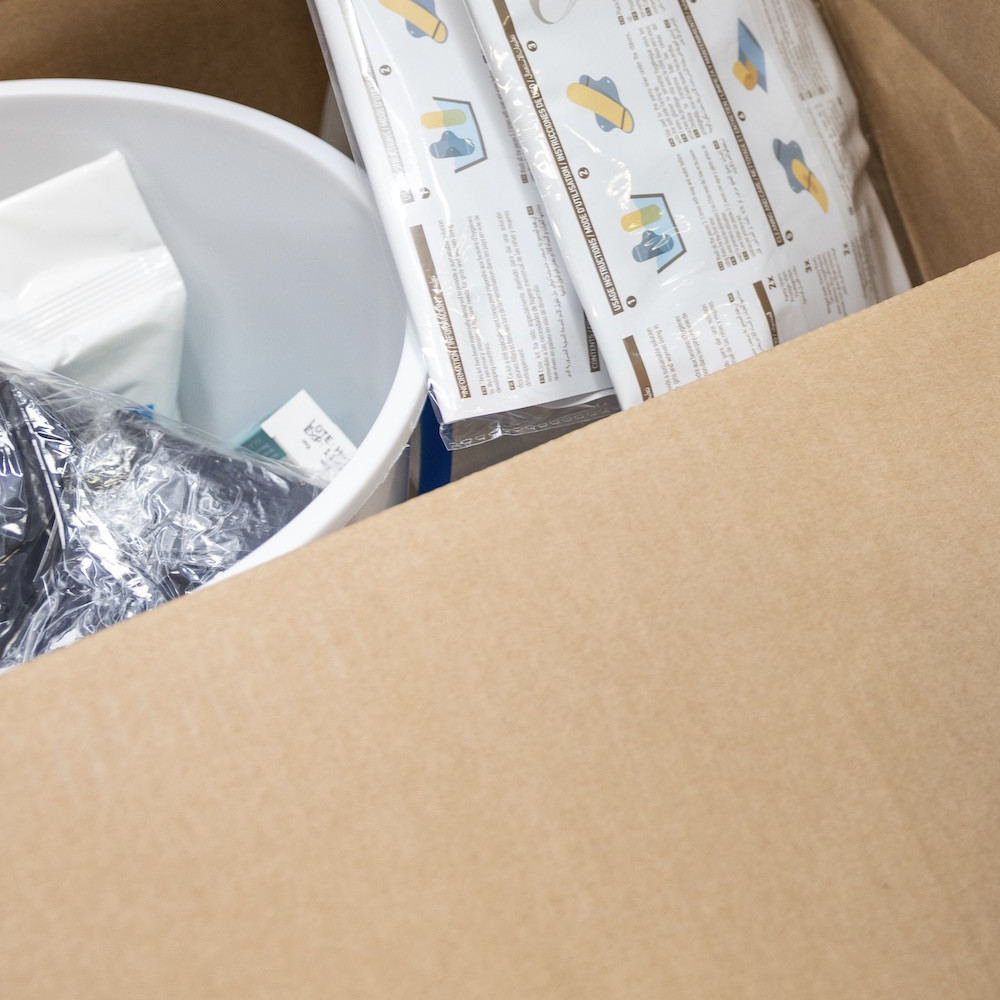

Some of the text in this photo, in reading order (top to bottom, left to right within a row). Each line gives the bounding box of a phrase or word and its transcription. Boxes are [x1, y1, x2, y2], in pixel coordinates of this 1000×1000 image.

[533, 96, 544, 108] DE
[537, 106, 565, 162] INSTRUCCIONES
[559, 165, 585, 214] D'UTILISATION
[754, 180, 766, 198] CARE
[760, 196, 772, 213] AND
[577, 212, 593, 235] MODE
[472, 241, 482, 261] besoins
[508, 254, 517, 267] para
[587, 236, 613, 288] INSTRUCTIONS
[451, 271, 462, 291] provide
[457, 295, 469, 319] designed
[605, 286, 622, 311] USAGE
[463, 318, 475, 344] especially
[469, 343, 478, 356] been
[448, 348, 469, 396] INFORMATION
[480, 351, 492, 378] necessary
[490, 365, 503, 393] developing
